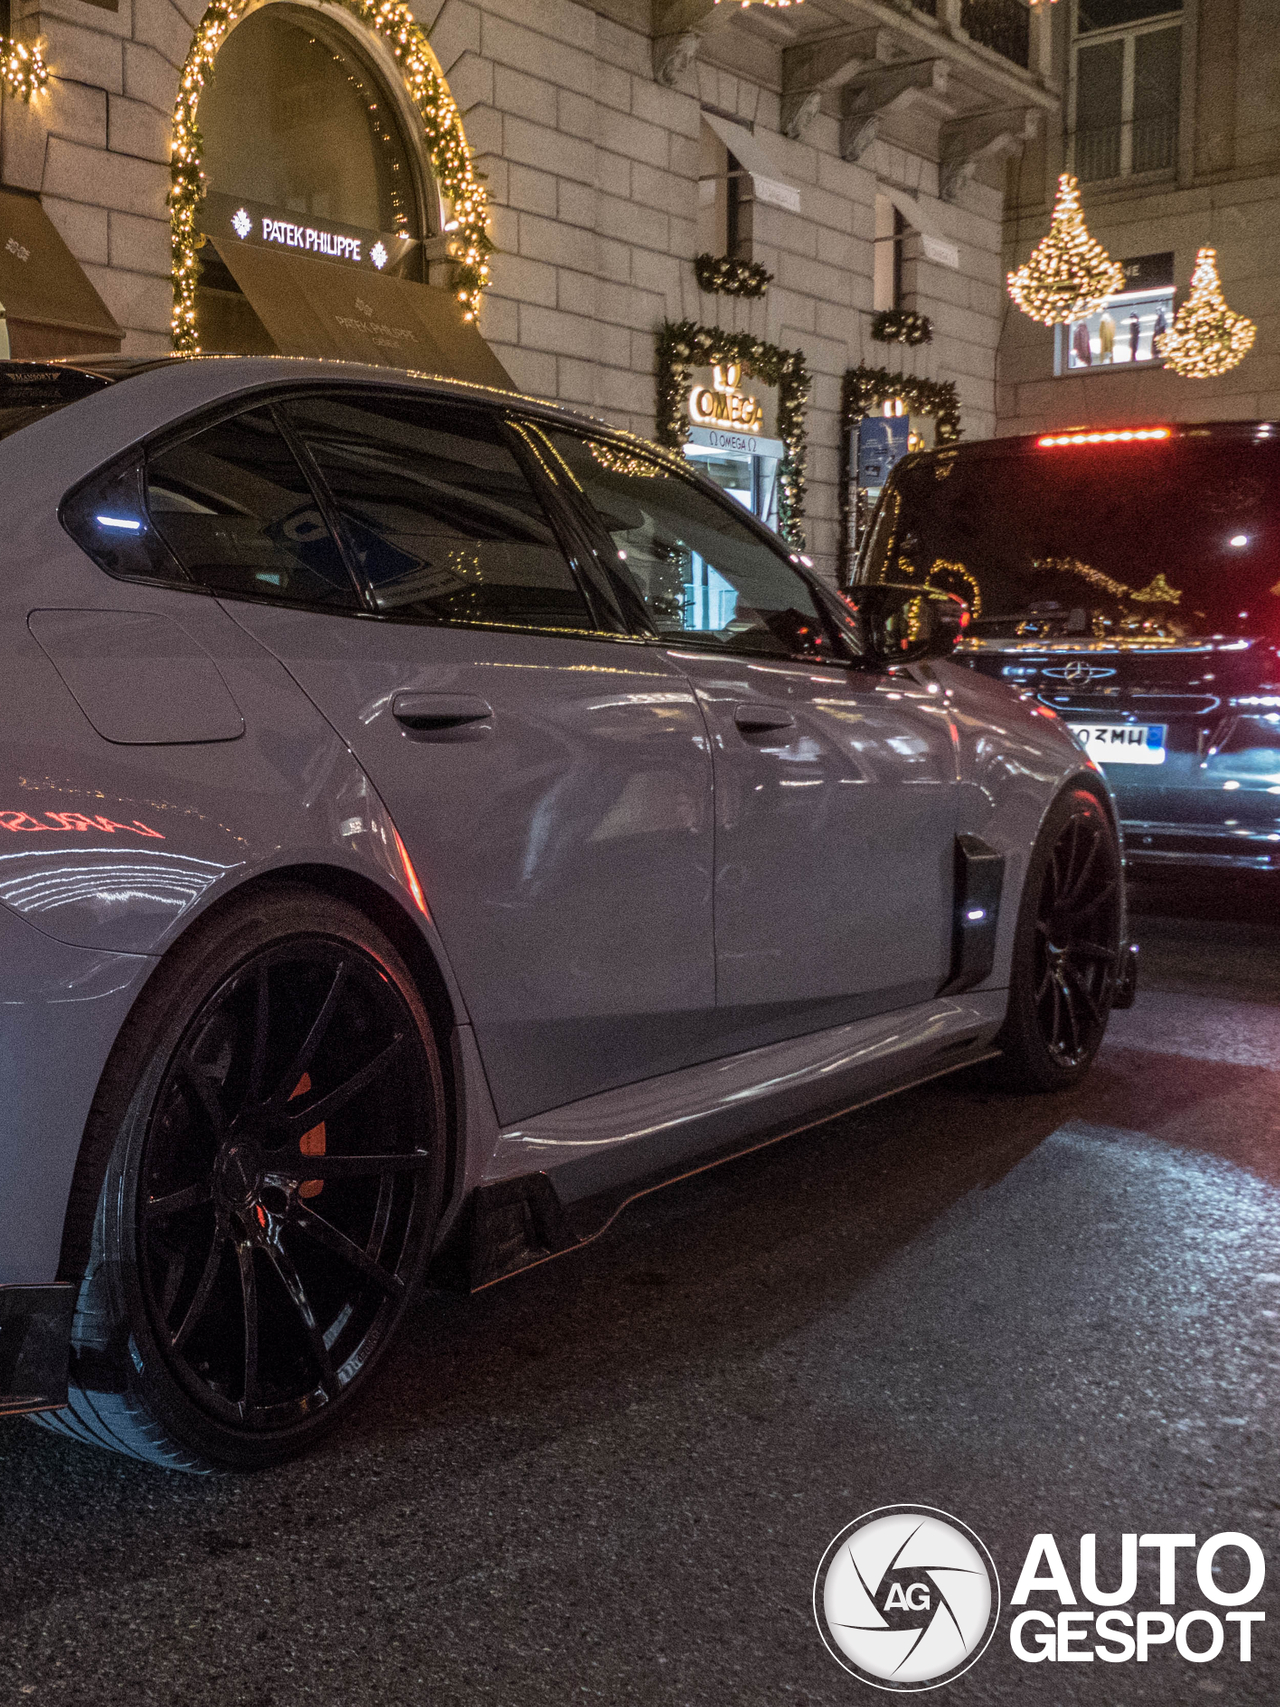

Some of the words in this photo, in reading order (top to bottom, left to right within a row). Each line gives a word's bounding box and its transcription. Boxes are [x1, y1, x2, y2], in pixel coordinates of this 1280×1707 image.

[262, 217, 304, 248] PATEK
[304, 228, 362, 261] PHILIPPE
[694, 388, 763, 429] OMEGA
[719, 434, 746, 449] OMEGA
